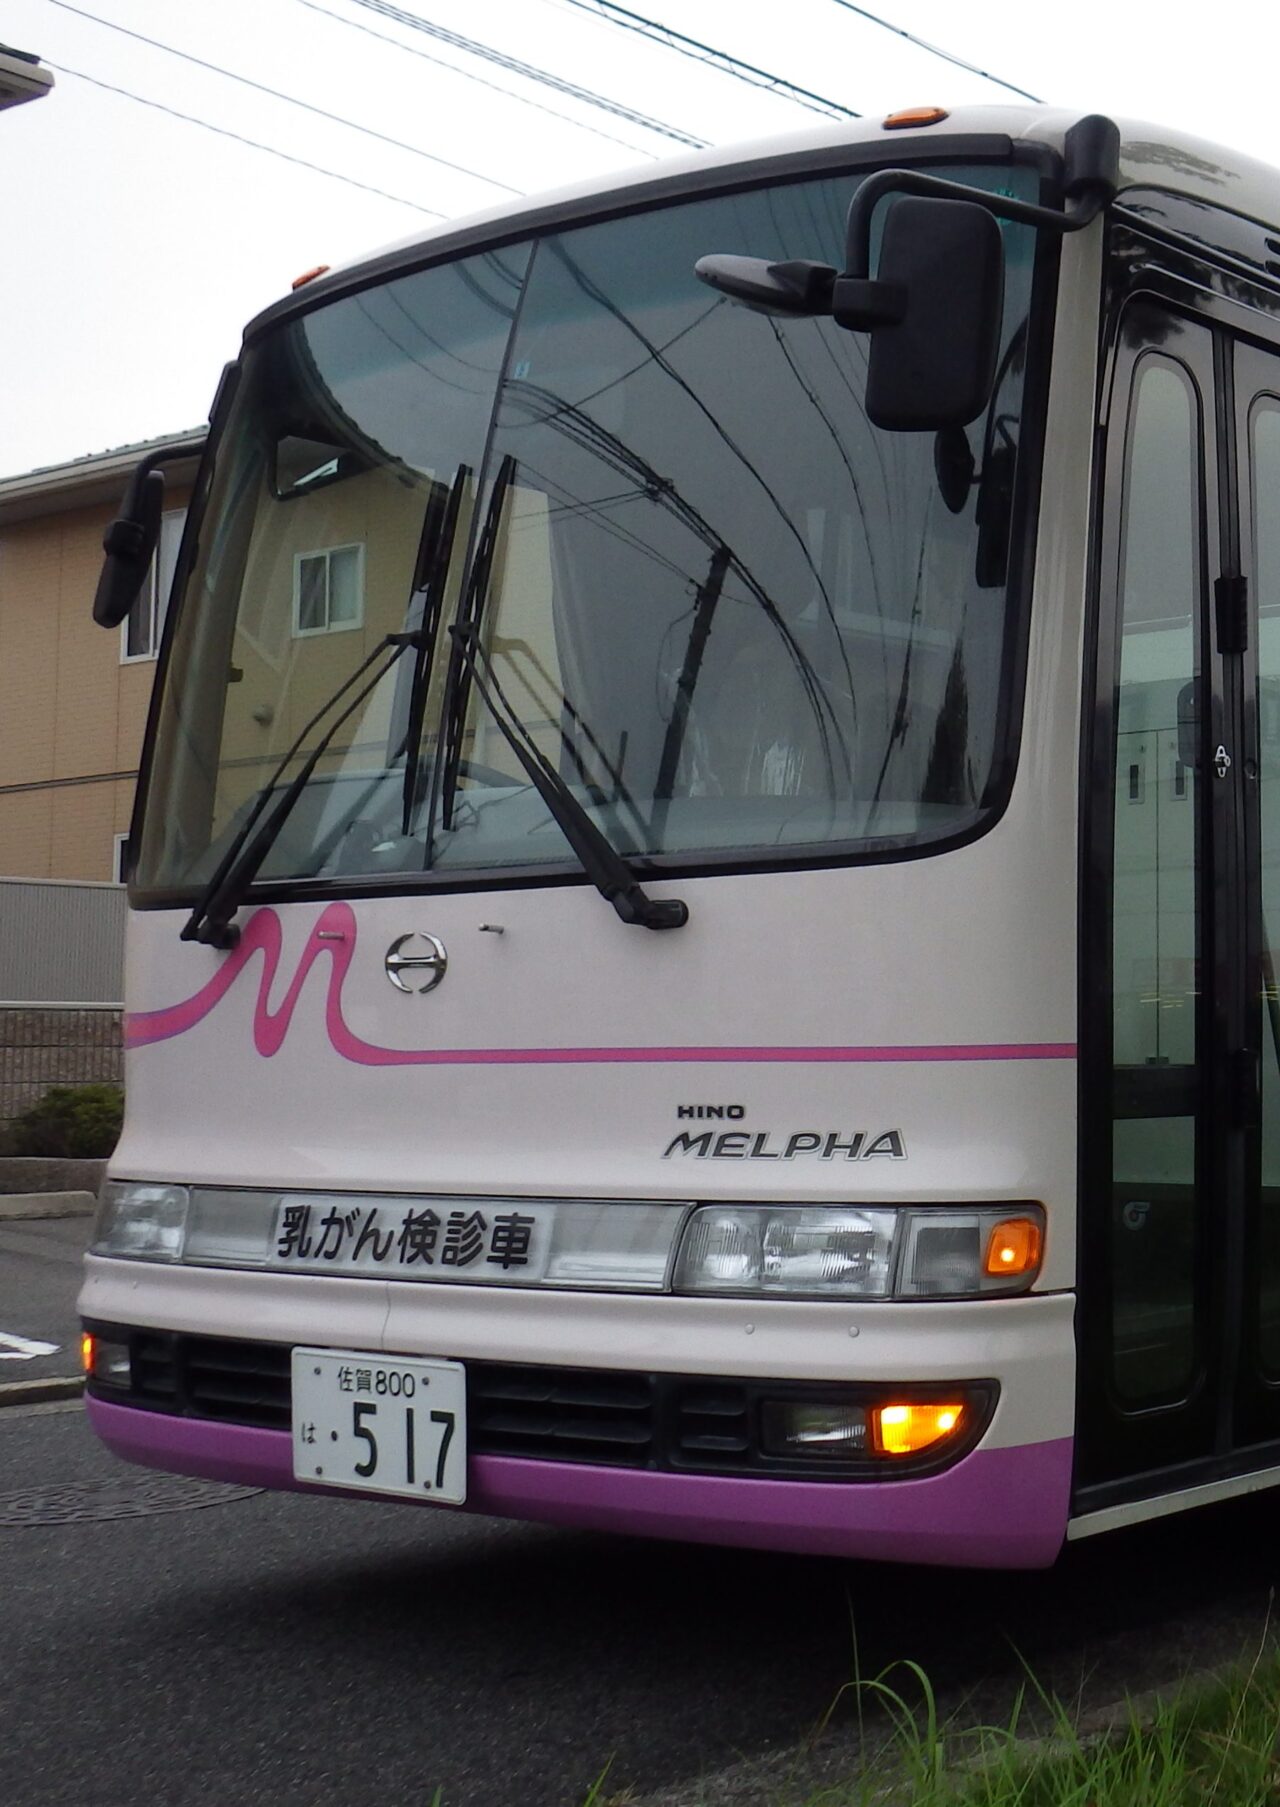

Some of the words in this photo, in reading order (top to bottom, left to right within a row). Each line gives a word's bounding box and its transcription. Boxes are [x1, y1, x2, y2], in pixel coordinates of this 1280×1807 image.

[678, 1105, 744, 1120] HINO
[661, 1129, 907, 1161] MELPHA
[278, 1205, 535, 1269] 乳がん検診車
